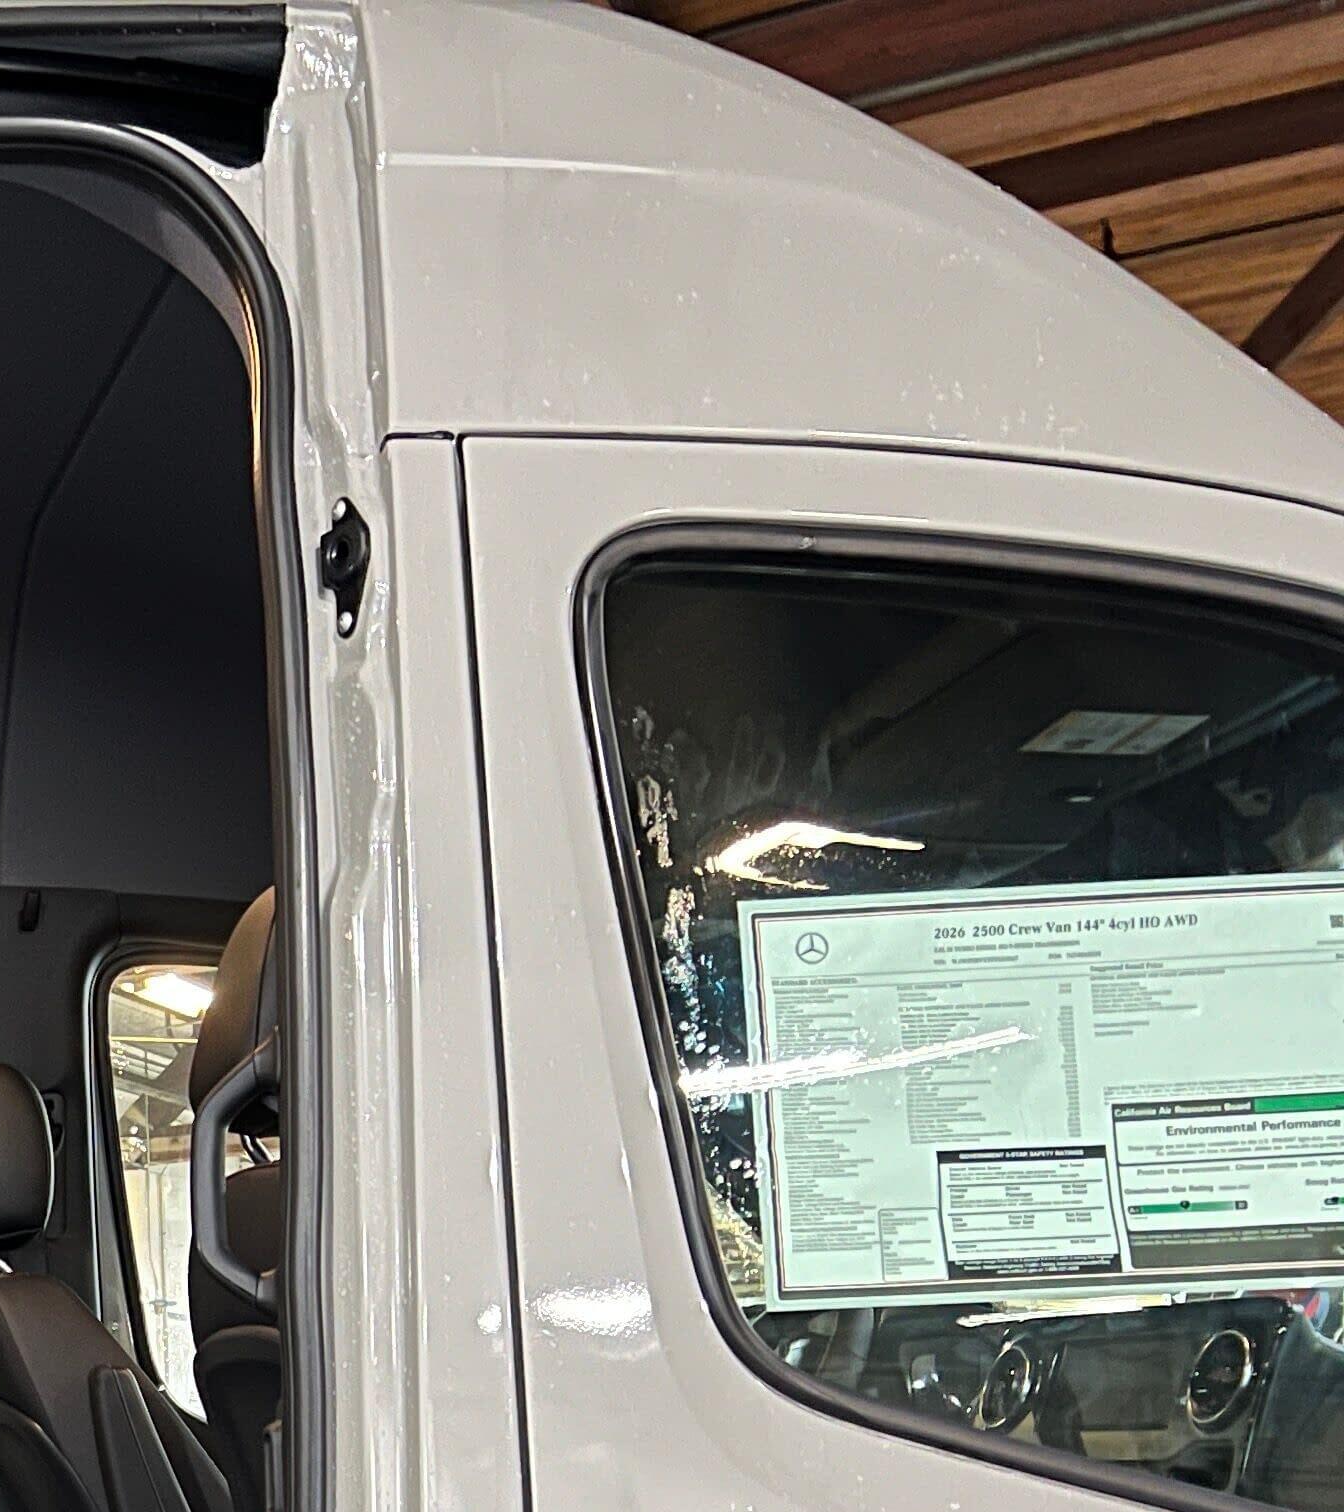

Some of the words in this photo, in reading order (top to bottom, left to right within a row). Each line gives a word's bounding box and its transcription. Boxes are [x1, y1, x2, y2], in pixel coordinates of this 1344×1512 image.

[934, 927, 965, 939] 2026
[972, 925, 1005, 937] 2500
[1008, 923, 1042, 935] Crew
[1046, 921, 1071, 933] Van
[1108, 917, 1135, 932] 4cyl
[1139, 916, 1161, 929] HO
[1164, 914, 1198, 928] AWD
[1165, 1121, 1257, 1136] Environmental
[1261, 1119, 1341, 1131] Performance
